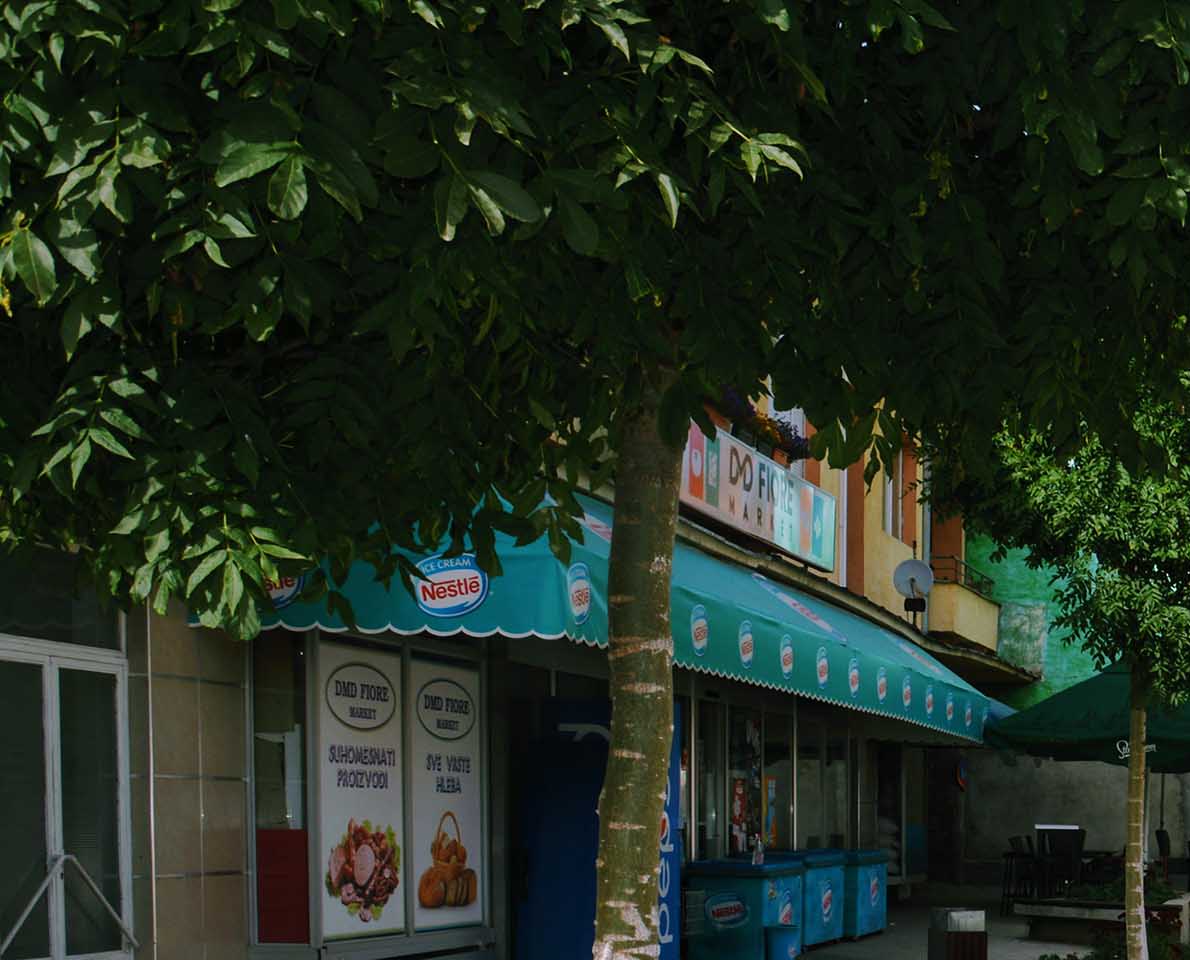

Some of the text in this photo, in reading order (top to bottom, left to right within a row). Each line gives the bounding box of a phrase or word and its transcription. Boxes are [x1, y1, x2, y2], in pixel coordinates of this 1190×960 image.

[437, 557, 472, 569] CREAM
[335, 680, 390, 702] DMD FIORE
[424, 694, 443, 711] DMD
[426, 753, 442, 772] SVE
[336, 768, 389, 789] PROIZVODI
